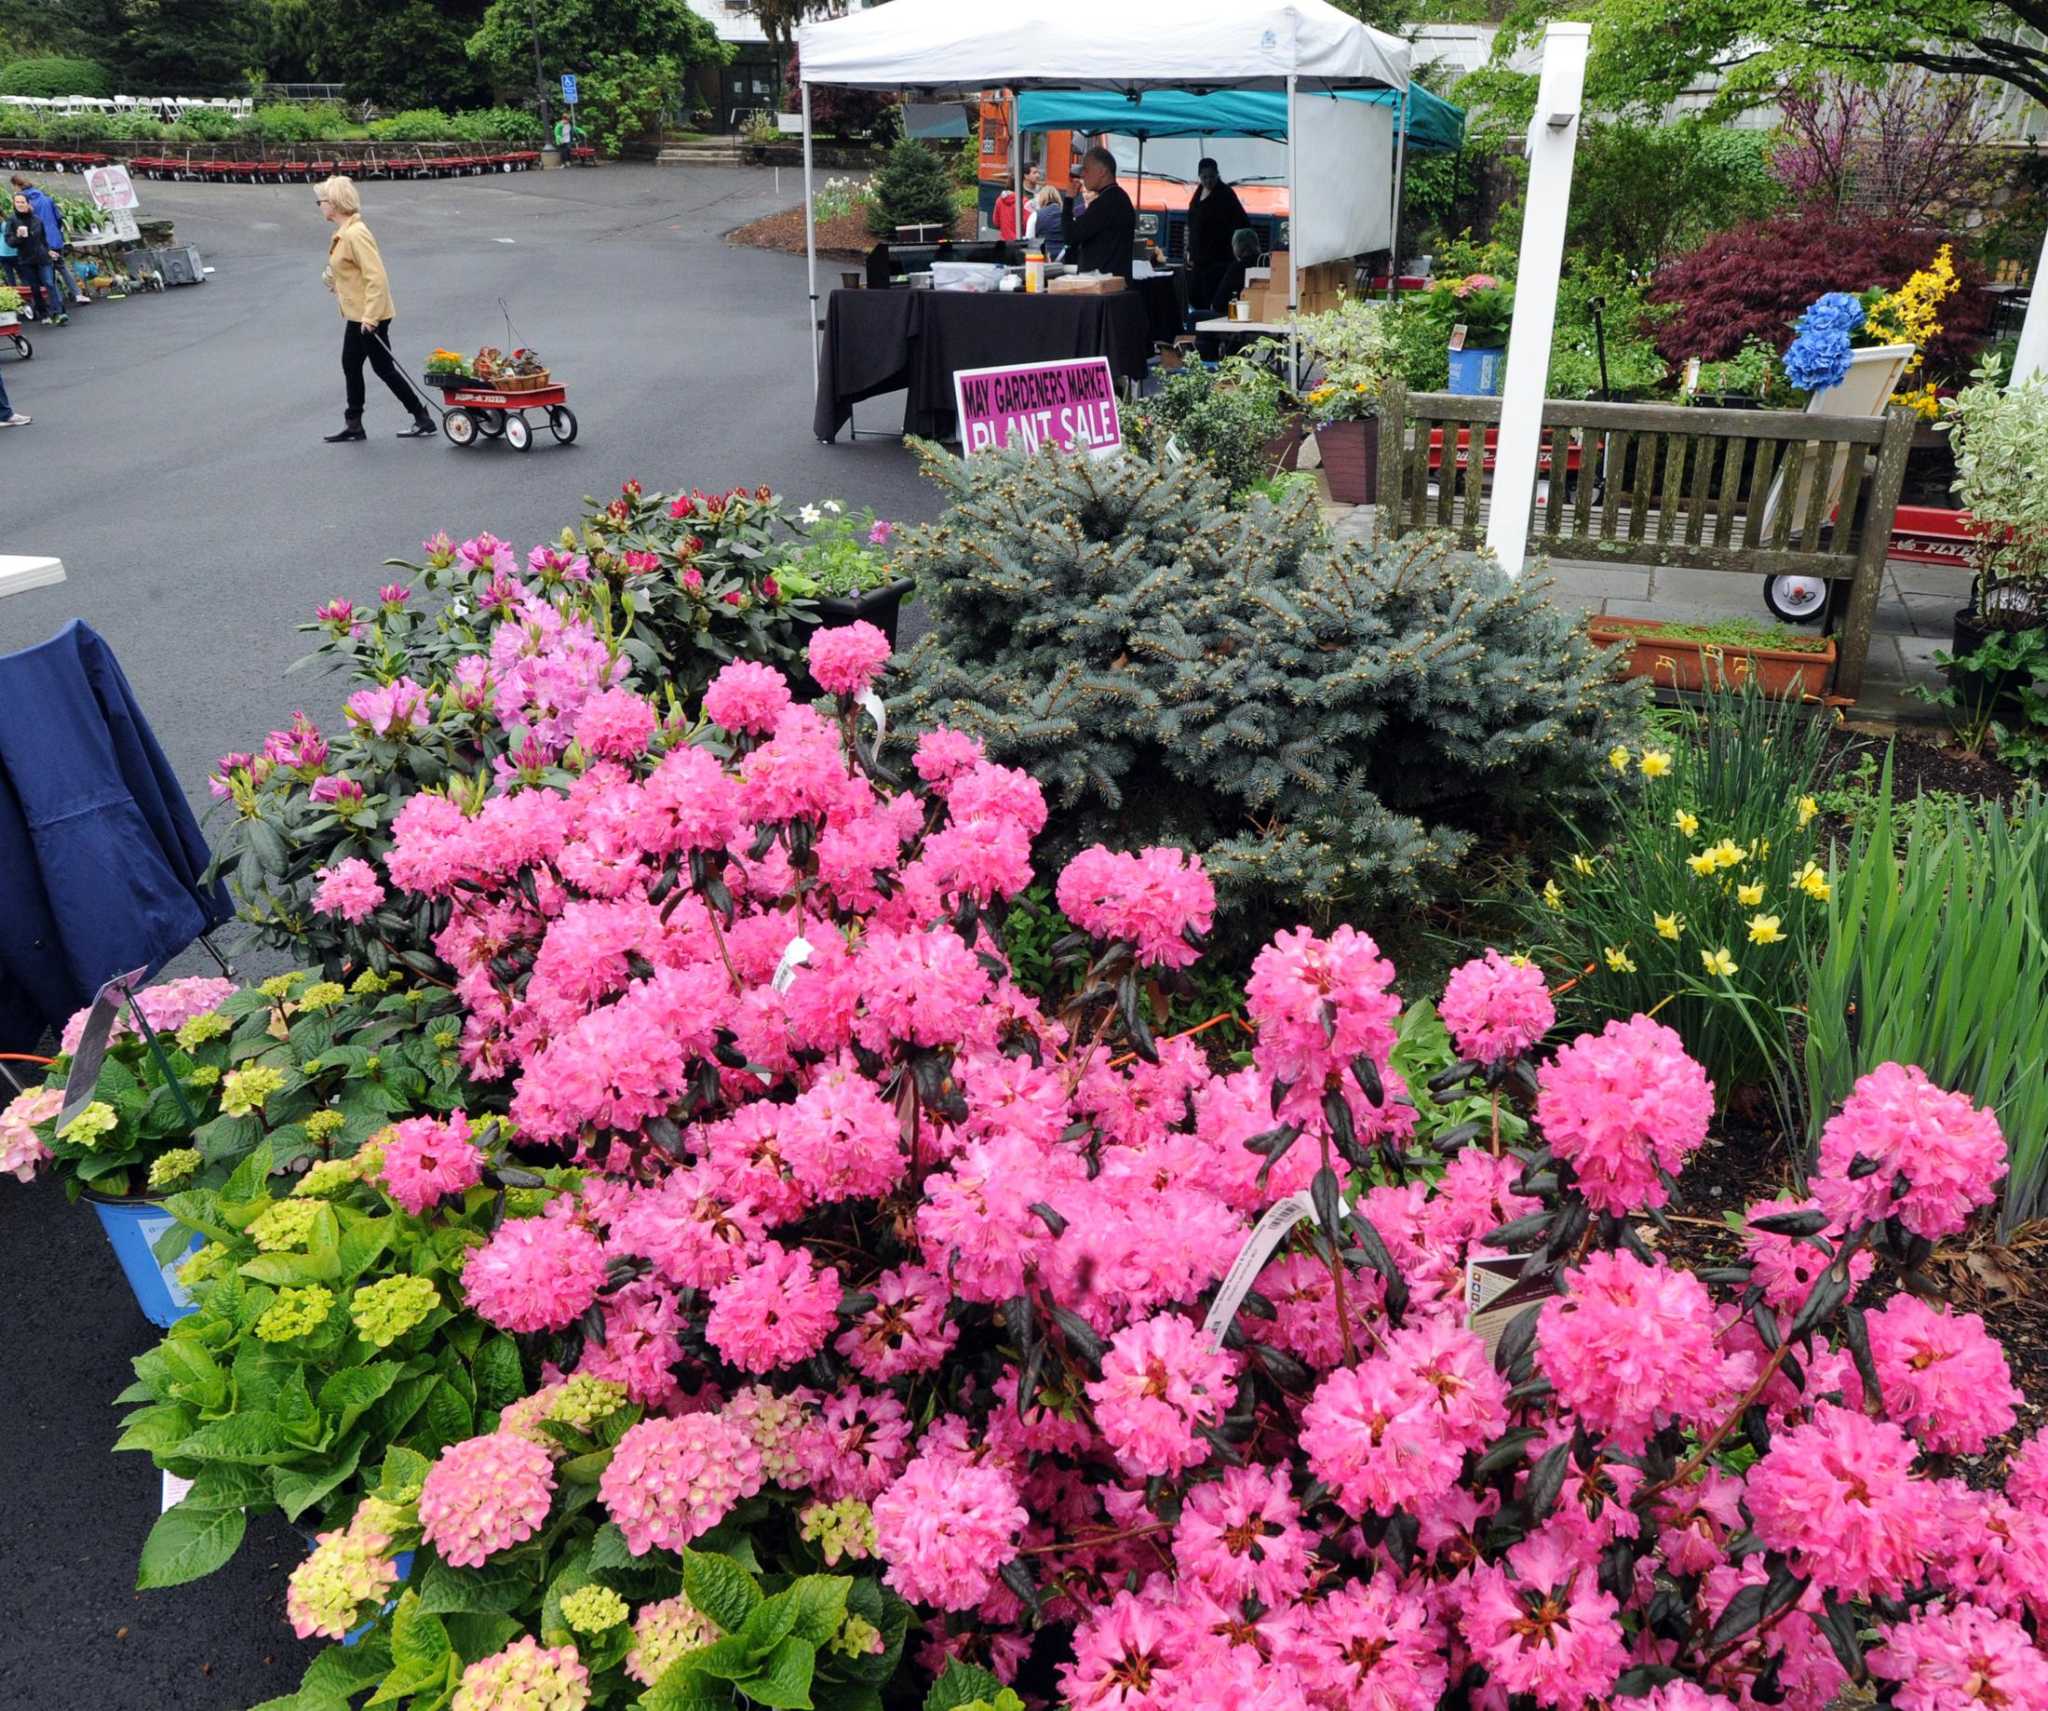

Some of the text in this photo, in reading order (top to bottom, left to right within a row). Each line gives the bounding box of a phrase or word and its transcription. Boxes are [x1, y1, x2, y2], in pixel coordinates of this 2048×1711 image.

[963, 365, 1110, 419] MAY GARDENERS MARKET
[1061, 401, 1115, 450] SALE
[1924, 542, 1978, 557] FLYE
